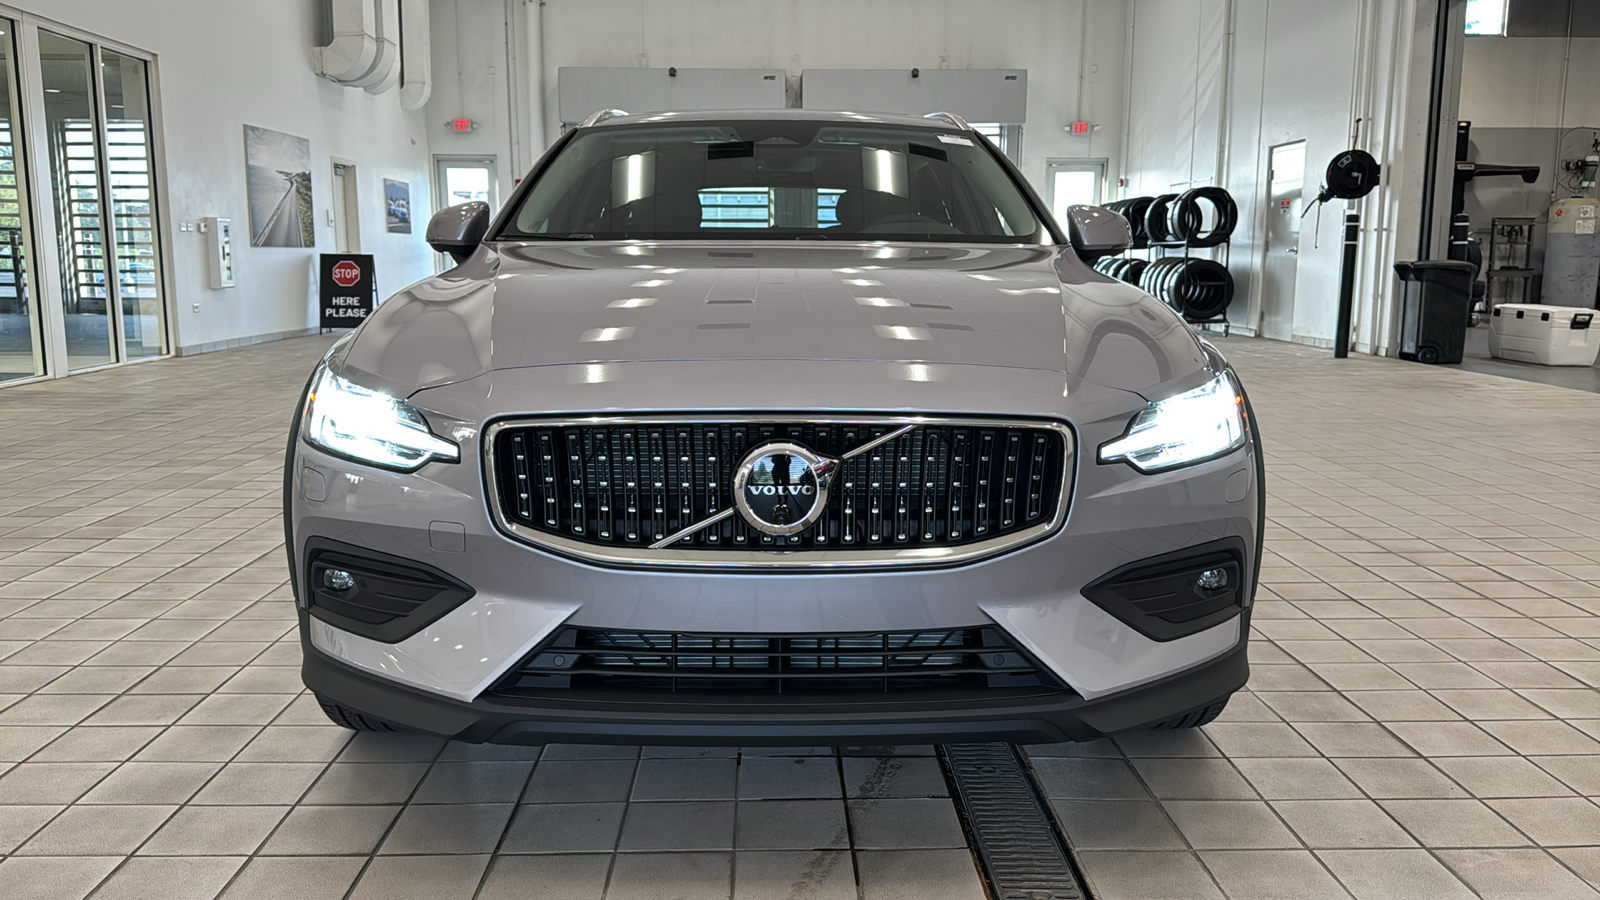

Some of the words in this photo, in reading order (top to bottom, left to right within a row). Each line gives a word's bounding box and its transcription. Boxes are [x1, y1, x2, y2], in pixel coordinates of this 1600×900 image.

[334, 268, 358, 279] STOP
[332, 296, 361, 306] HERE
[325, 308, 367, 318] PLEASE
[747, 485, 815, 496] VOLVO
